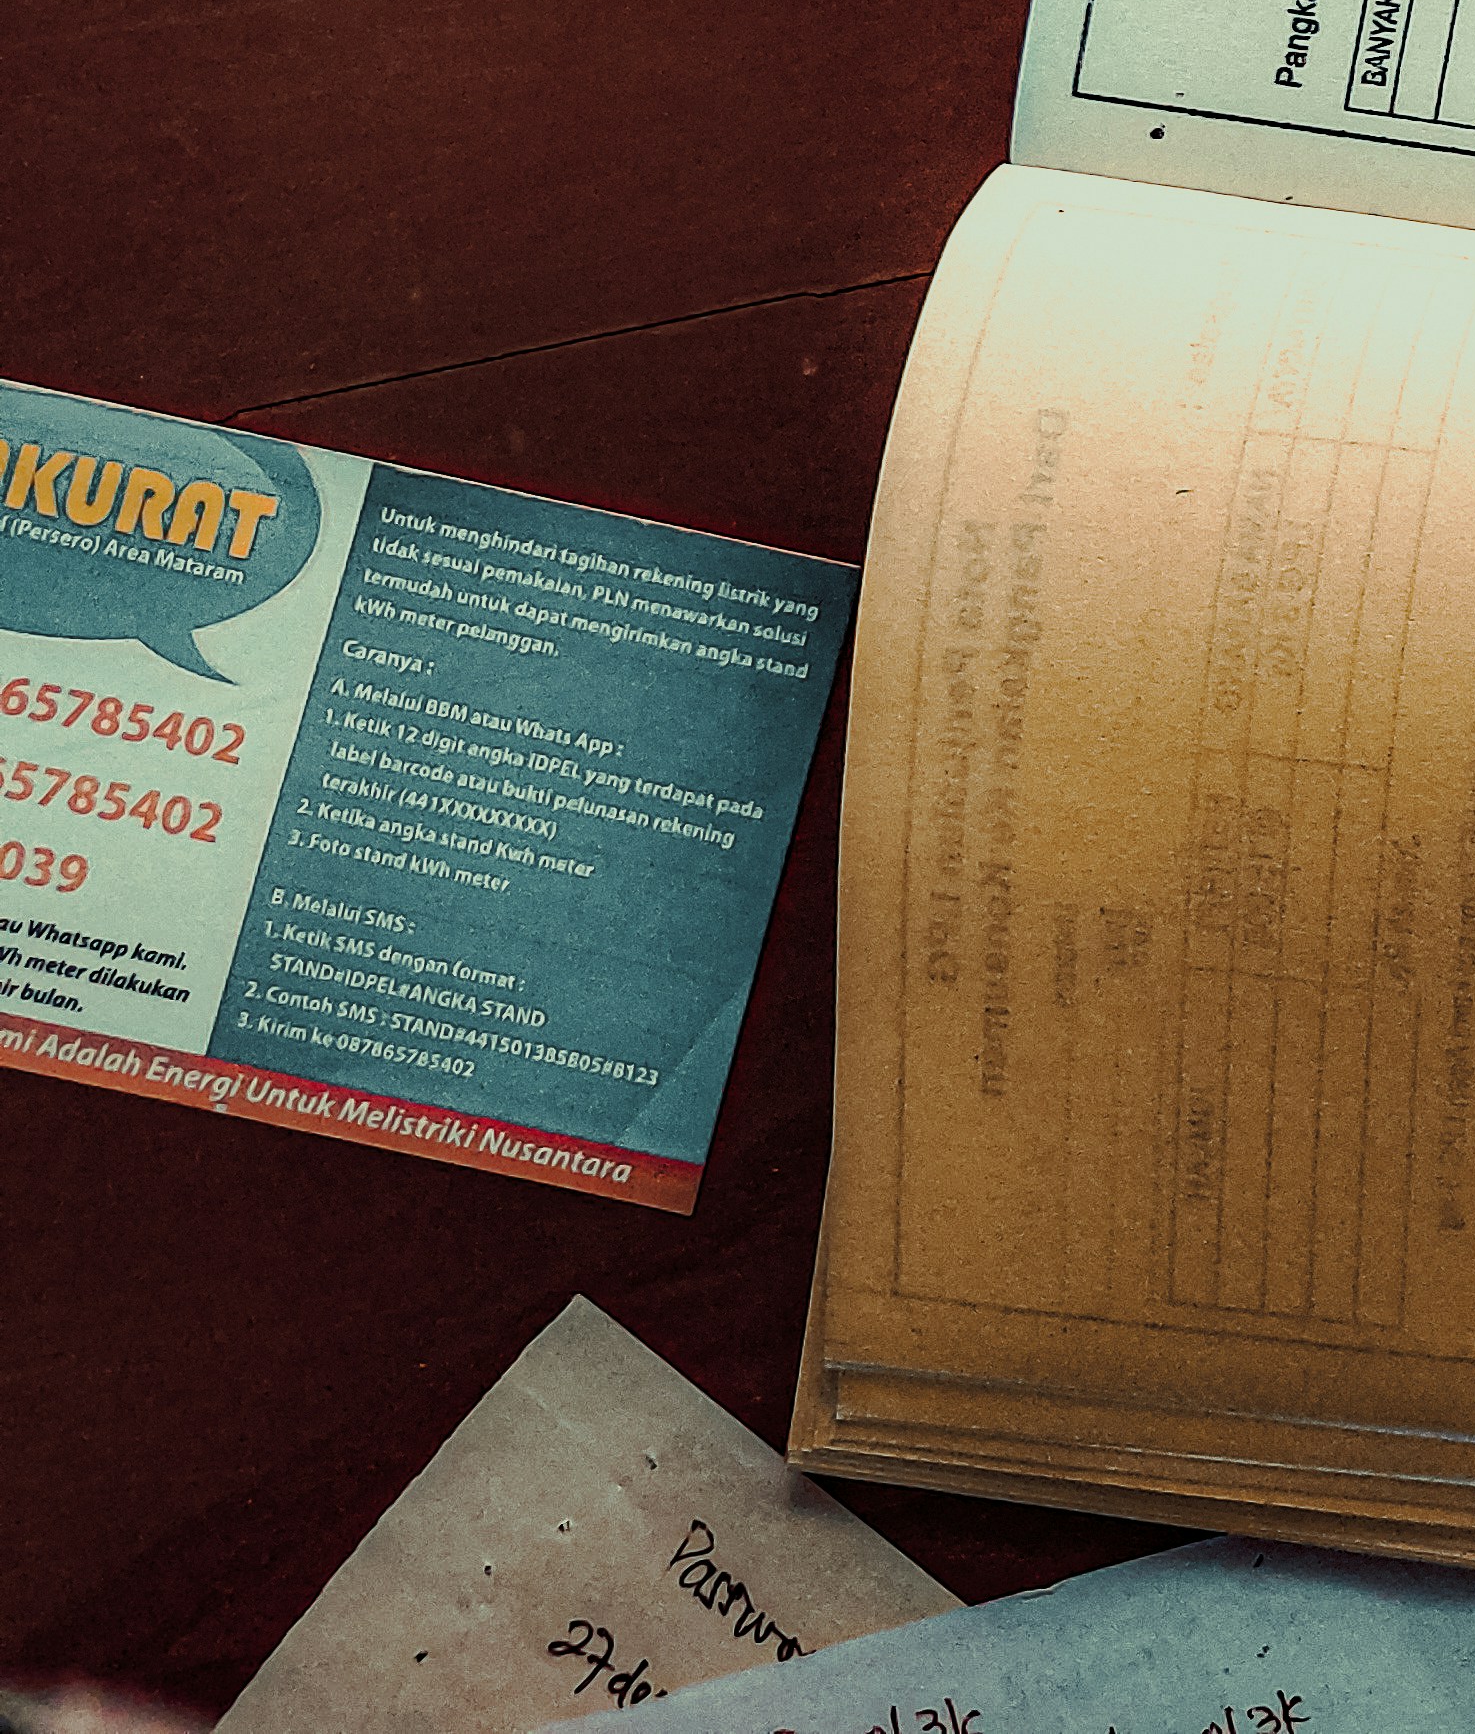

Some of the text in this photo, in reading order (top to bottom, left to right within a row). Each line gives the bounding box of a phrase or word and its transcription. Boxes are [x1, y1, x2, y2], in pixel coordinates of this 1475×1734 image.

[0, 440, 276, 557] KURAT
[11, 519, 243, 584] (Persero) Area Mataram
[382, 507, 818, 621] Untuk menghindari tagihan rekening listrik yang
[364, 569, 808, 678] termudah untuk dapat mengirimkan angka stand
[373, 537, 419, 562] tidak
[592, 586, 629, 607] PLN
[631, 599, 749, 633] menawarkan
[753, 626, 806, 646] solusi
[343, 641, 422, 672] Caranya
[355, 595, 558, 656] kWh meter pelanggan.
[354, 684, 613, 757] Melalui BBM atau Whats App
[716, 800, 763, 818] pada
[28, 920, 186, 970] Whatsapp kami.
[21, 983, 82, 1012] bulan.
[24, 957, 190, 1002] meter dilakukan
[36, 1035, 631, 1182] Adalah Energi Untuk Melistriki Nusantara
